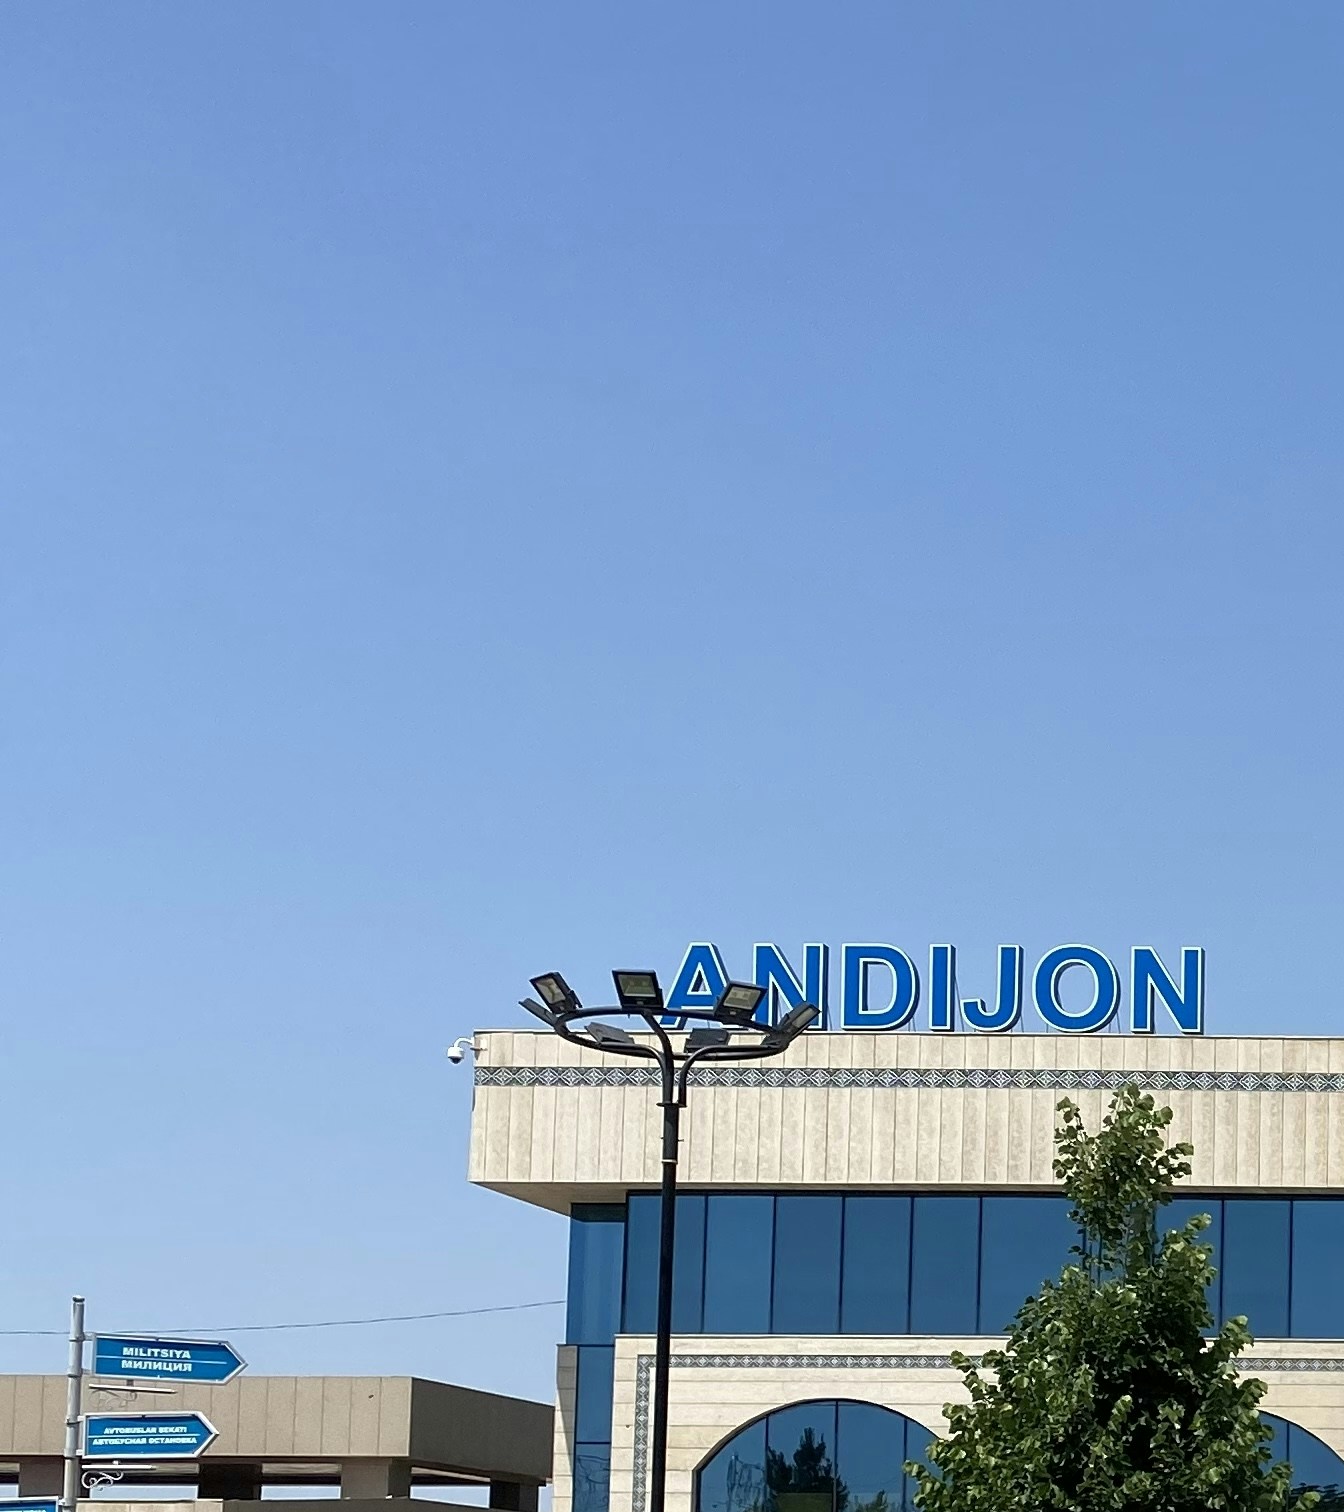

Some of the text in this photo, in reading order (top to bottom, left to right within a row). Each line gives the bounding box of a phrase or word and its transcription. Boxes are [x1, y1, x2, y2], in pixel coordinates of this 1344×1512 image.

[659, 942, 1204, 1035] ANDIJON
[122, 1346, 191, 1359] MILITSIYA
[121, 1360, 193, 1372] МИЛИЦИЯ
